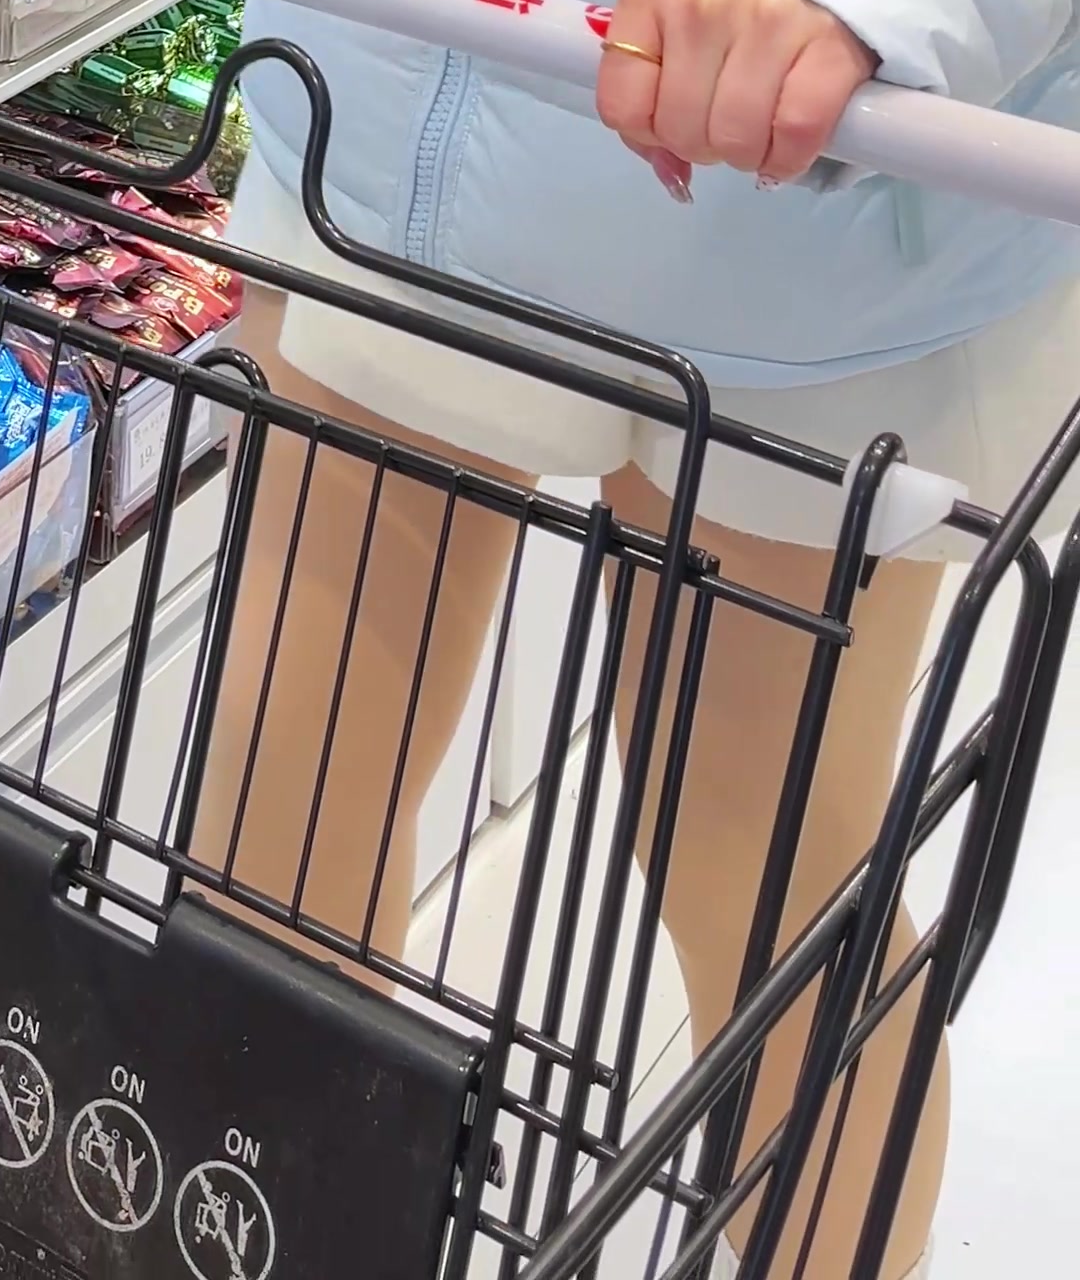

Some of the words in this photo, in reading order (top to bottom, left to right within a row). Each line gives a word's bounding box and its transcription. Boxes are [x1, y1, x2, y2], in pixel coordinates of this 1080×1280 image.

[6, 1006, 42, 1046] NO
[110, 1064, 148, 1105] NO
[224, 1126, 262, 1169] NO
